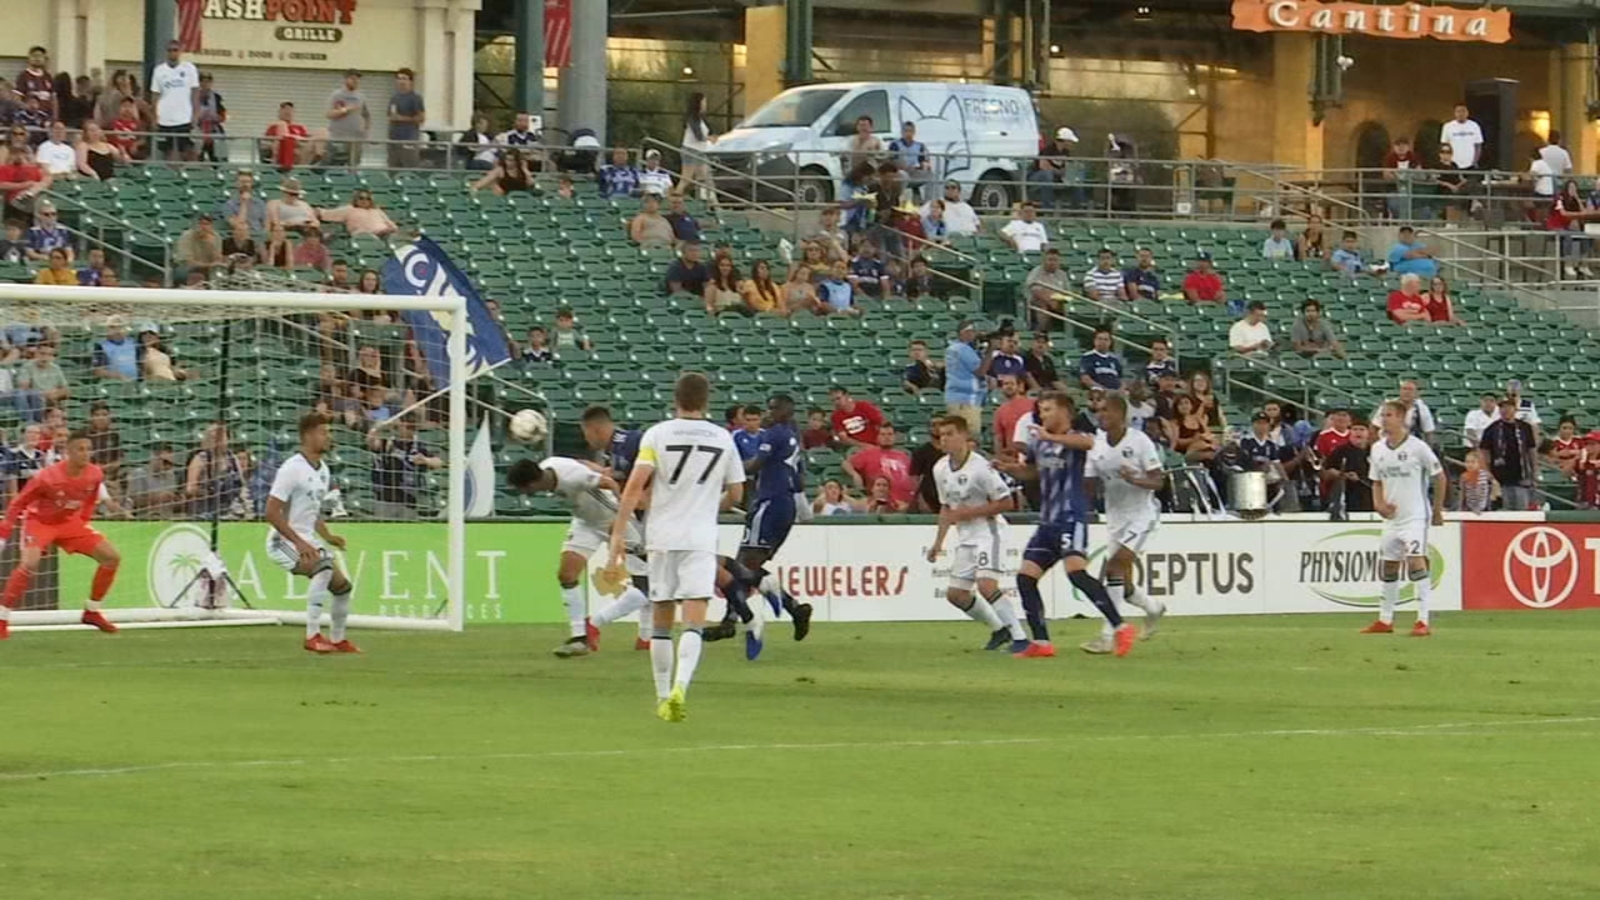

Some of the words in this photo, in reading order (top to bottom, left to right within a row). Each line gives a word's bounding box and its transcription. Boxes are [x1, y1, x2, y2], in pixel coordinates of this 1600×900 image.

[1269, 1, 1488, 36] Cantina
[283, 28, 336, 41] GRILLE
[665, 444, 724, 485] 77
[1060, 533, 1071, 549] 5
[1123, 530, 1137, 544] 7
[978, 551, 989, 566] 8
[1298, 551, 1380, 582] PHYSIOM
